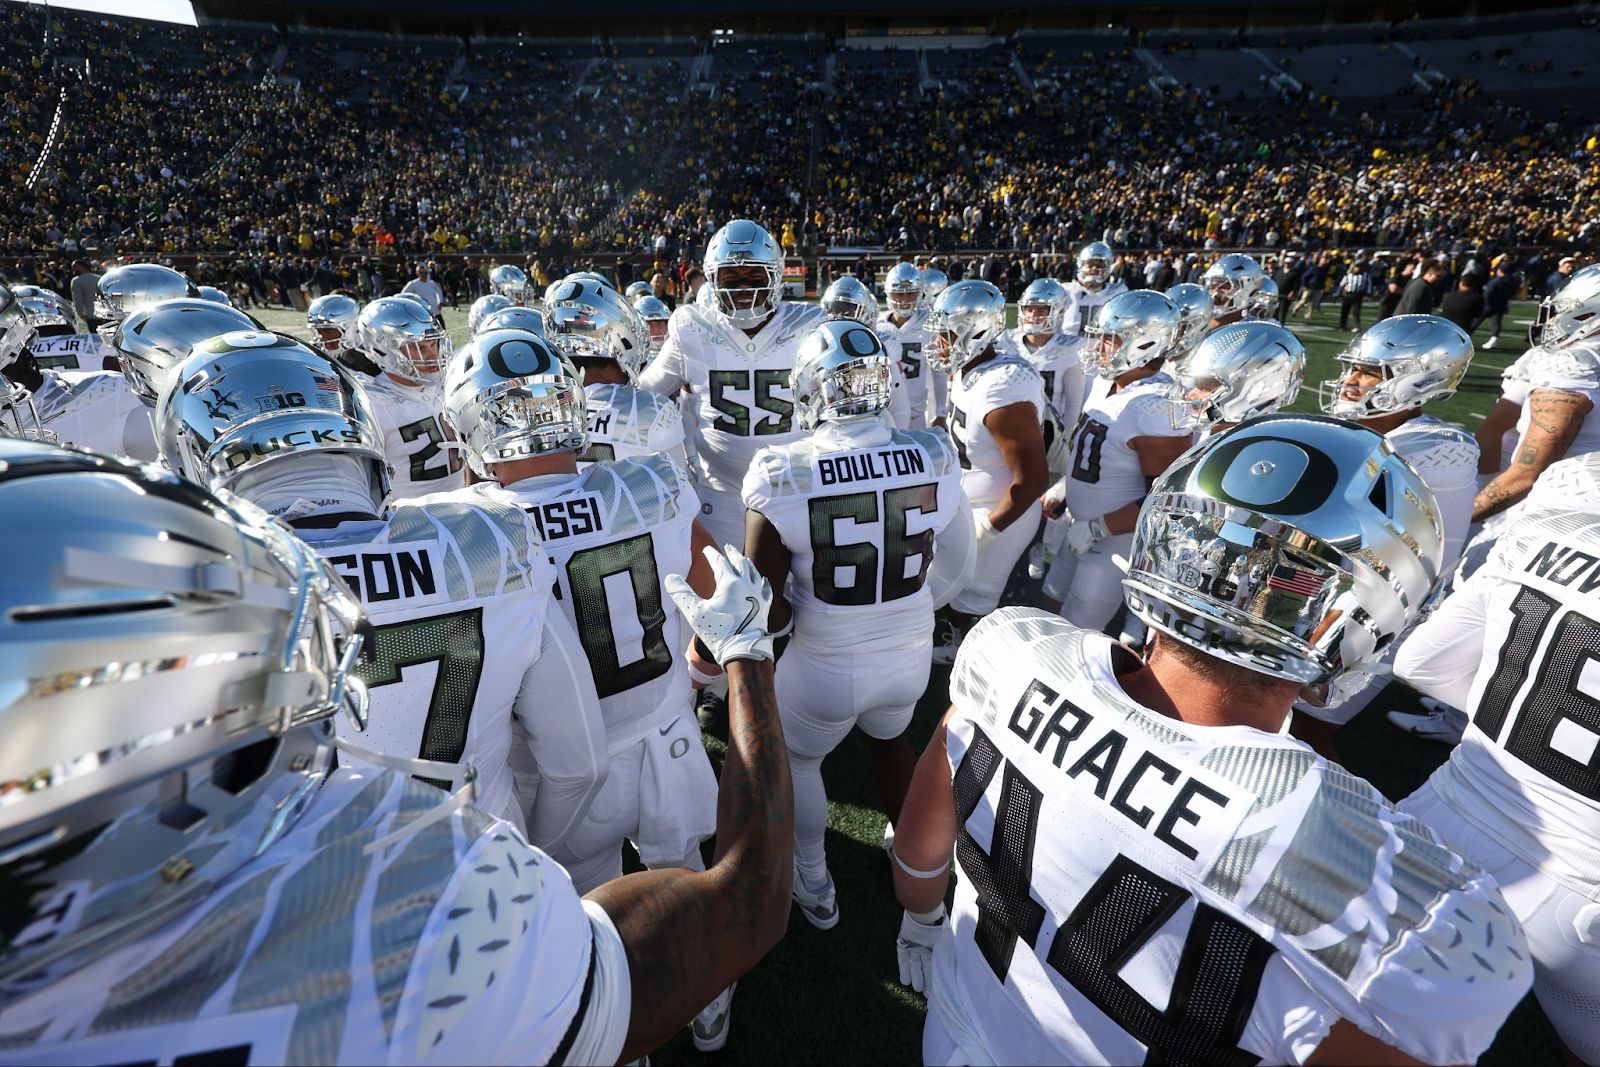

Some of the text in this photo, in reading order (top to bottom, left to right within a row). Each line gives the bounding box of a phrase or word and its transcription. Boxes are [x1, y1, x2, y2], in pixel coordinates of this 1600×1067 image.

[60, 340, 80, 351] JR
[708, 368, 794, 437] 55
[225, 429, 363, 472] DUCKS
[500, 437, 582, 458] DUCKS
[818, 448, 925, 486] BOULTON
[808, 482, 939, 606] 66
[549, 531, 673, 700] 0
[1128, 592, 1286, 672] DUCKS
[333, 606, 486, 792] 7
[1007, 678, 1231, 861] GRACE
[952, 721, 1279, 1067] 44
